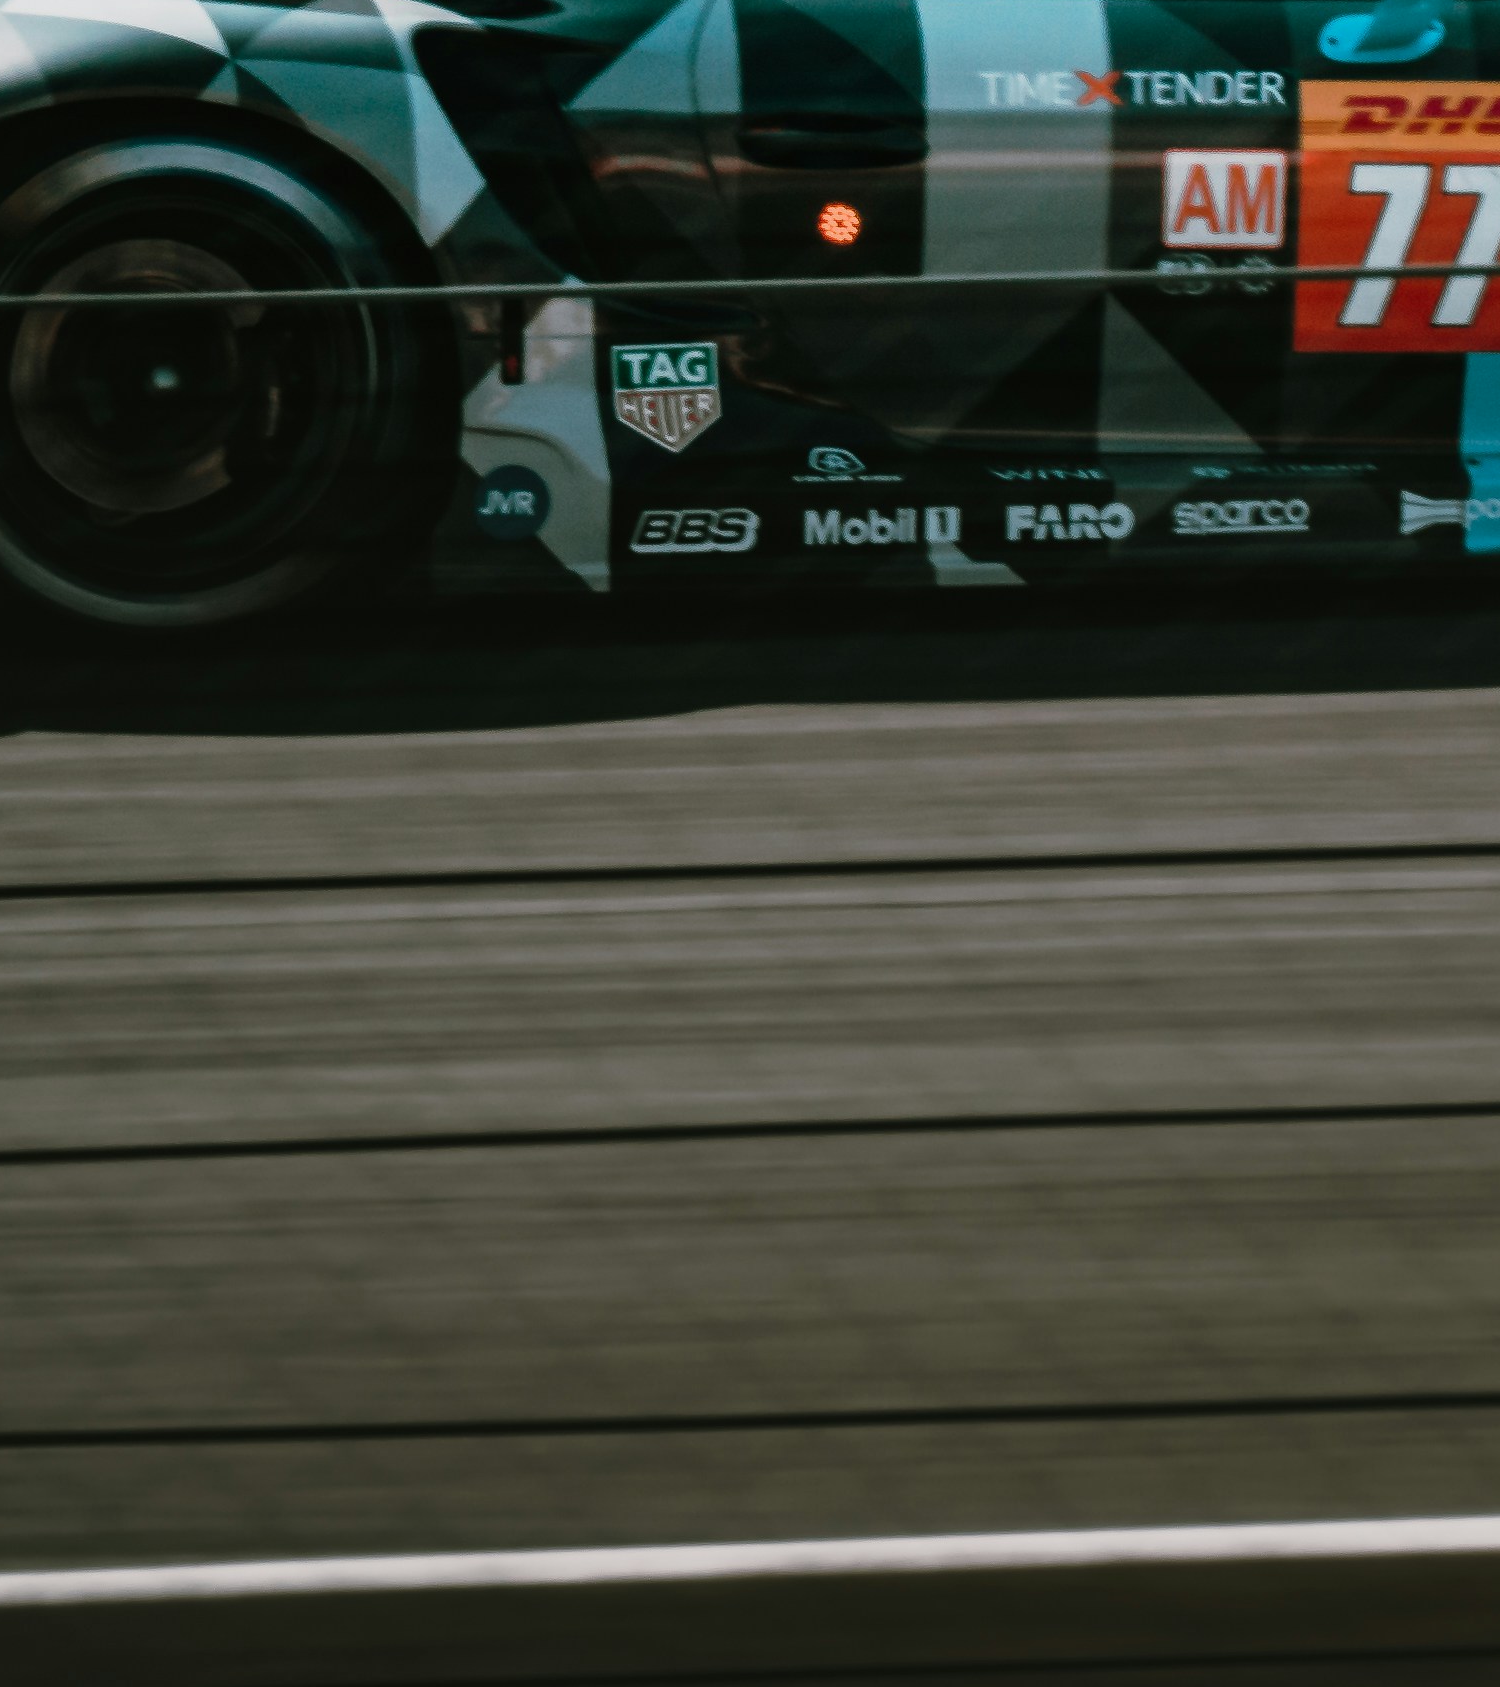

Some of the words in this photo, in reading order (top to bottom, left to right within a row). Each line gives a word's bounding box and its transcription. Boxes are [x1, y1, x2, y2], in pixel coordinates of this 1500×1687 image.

[980, 69, 1286, 106] TIMEXTENDER
[1173, 163, 1277, 236] AM
[622, 350, 708, 385] TAG
[622, 391, 713, 443] HEUER
[631, 508, 761, 554] BBS
[803, 506, 918, 544] Mobil
[1006, 502, 1136, 543] FARO
[1174, 498, 1310, 528] sparco
